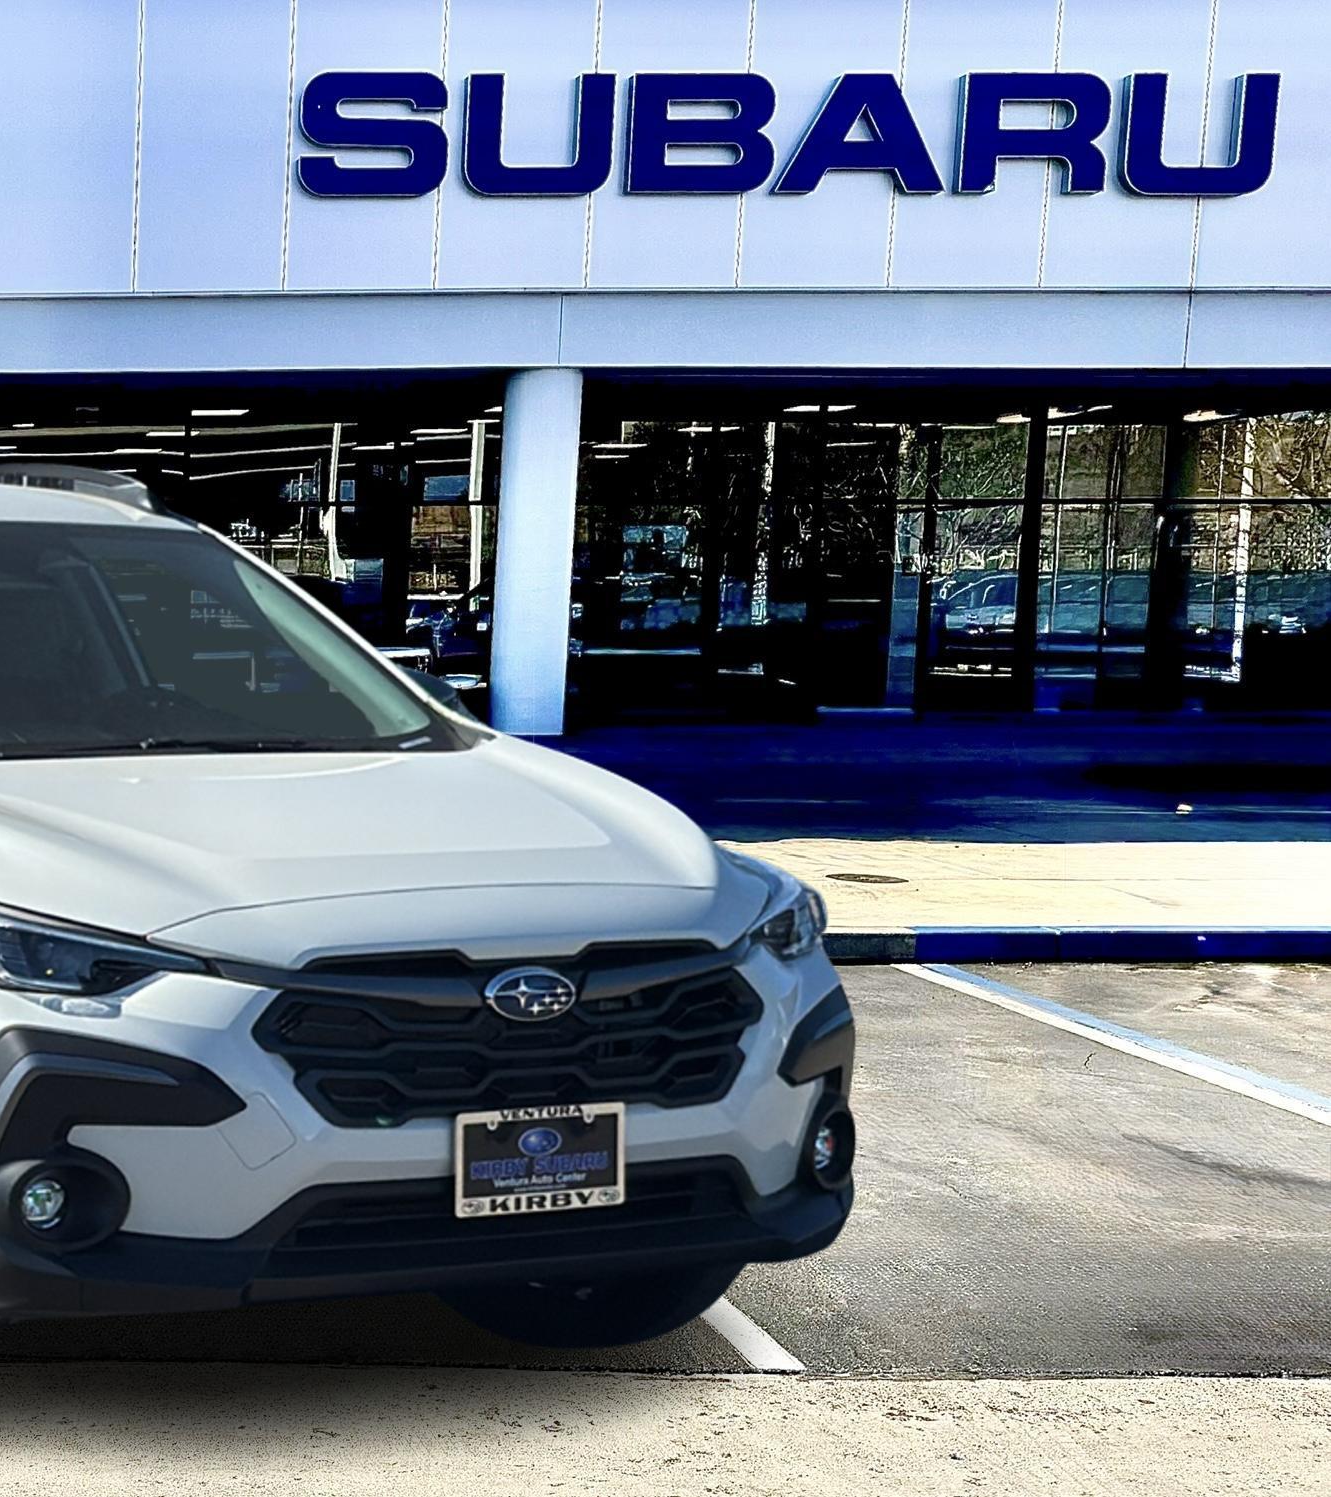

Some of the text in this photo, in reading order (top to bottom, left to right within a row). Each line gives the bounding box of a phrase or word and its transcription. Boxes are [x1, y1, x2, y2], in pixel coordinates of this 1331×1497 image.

[296, 71, 1282, 197] SUBARU
[500, 1105, 584, 1121] VENTURA
[471, 1151, 608, 1180] KIRBY SUBARU
[493, 1177, 529, 1189] Ventura
[531, 1174, 554, 1185] Auto
[556, 1172, 587, 1183] Center
[490, 1191, 594, 1212] KIRBY
